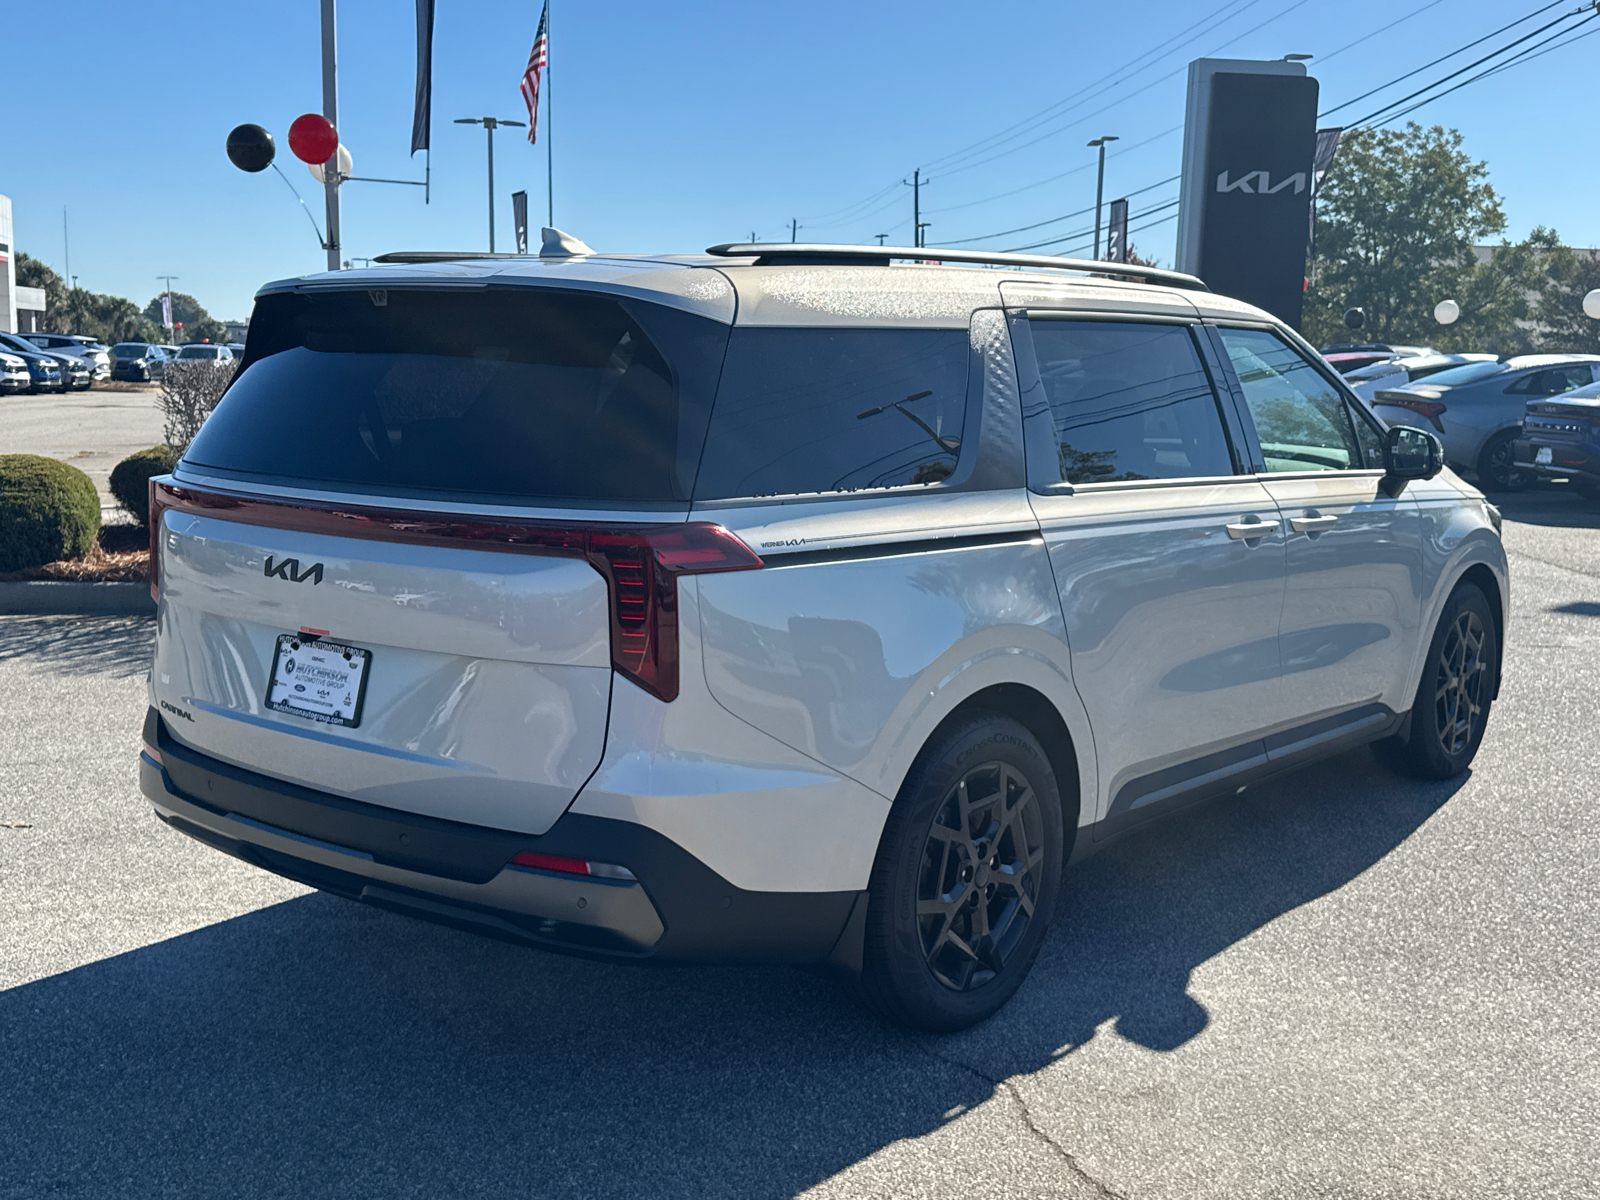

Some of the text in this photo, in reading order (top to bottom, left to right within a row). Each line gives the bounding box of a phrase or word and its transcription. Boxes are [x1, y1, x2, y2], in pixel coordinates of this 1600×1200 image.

[1216, 170, 1306, 195] KIA
[785, 538, 806, 547] KIA
[263, 555, 324, 585] KIA
[312, 640, 346, 654] AUTOMOTIVE
[345, 647, 366, 657] GROUP
[311, 655, 325, 663] GMC
[295, 674, 326, 686] AUTOMOTIVE
[326, 681, 345, 689] GROUP
[296, 663, 349, 683] HUTCHINSON
